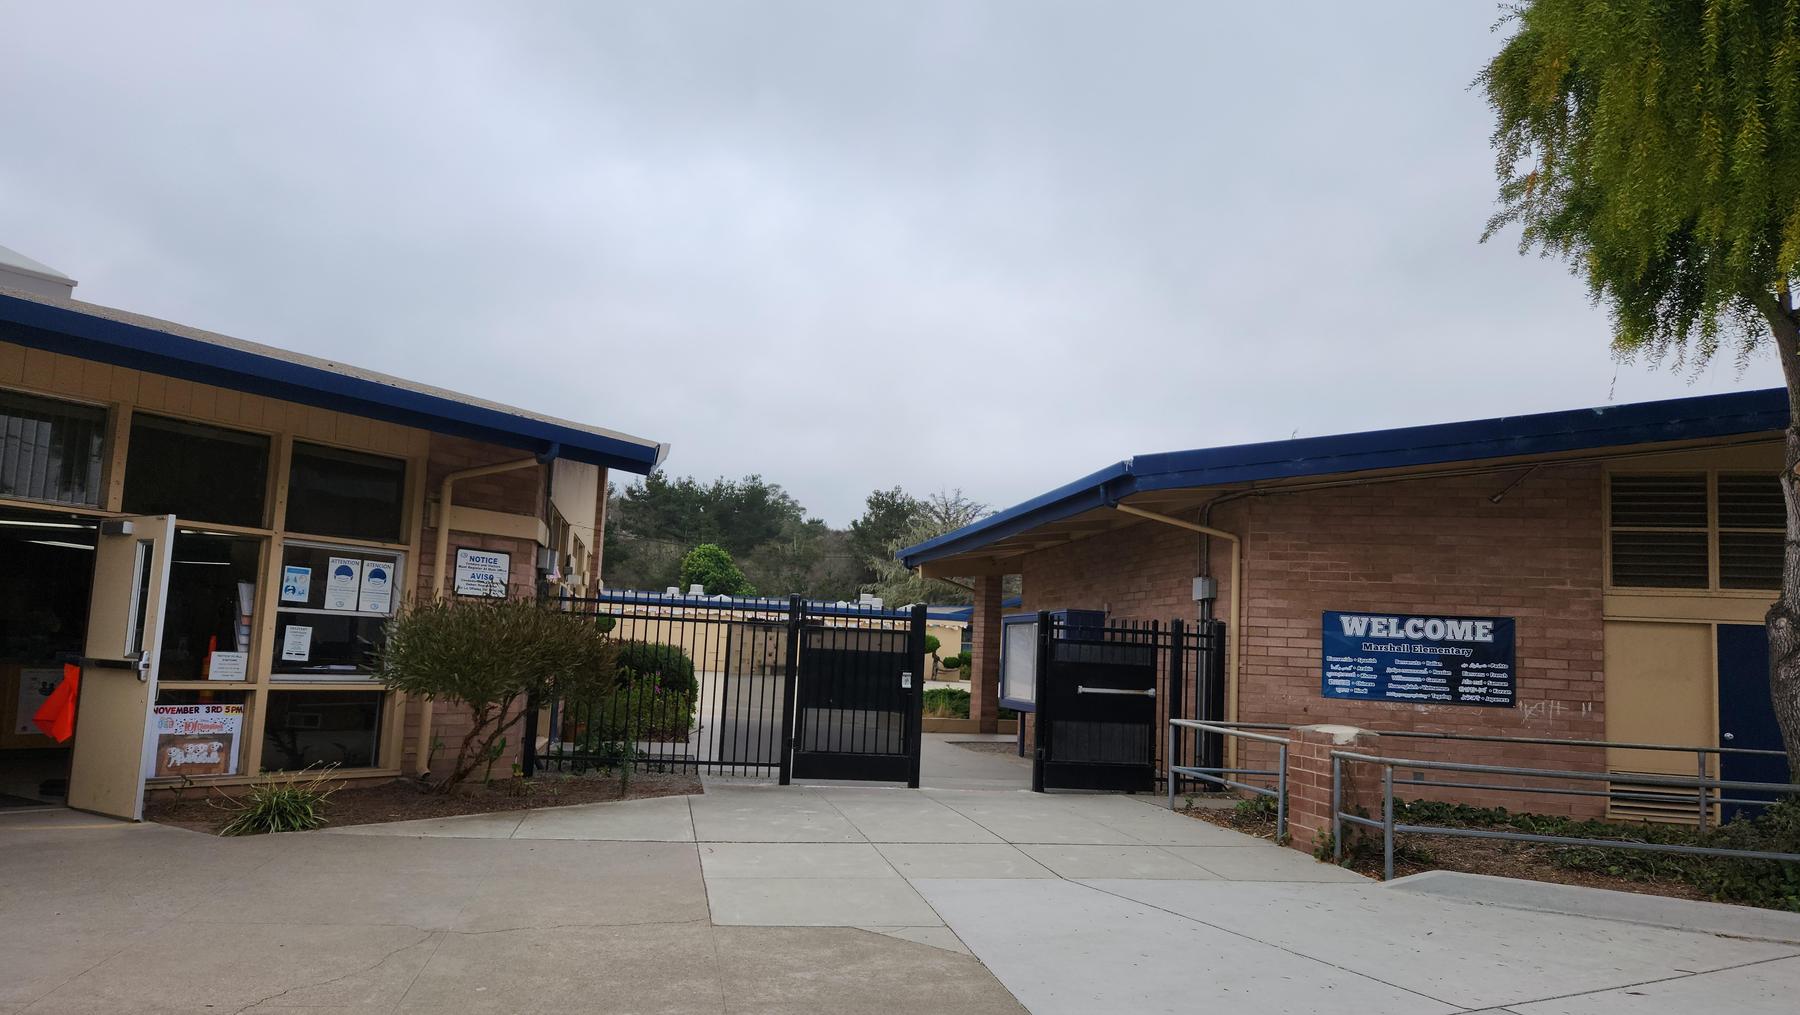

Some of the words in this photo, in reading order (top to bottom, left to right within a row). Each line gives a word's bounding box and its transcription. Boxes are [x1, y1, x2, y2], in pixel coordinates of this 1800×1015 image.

[470, 556, 498, 564] NOTICE
[1339, 615, 1494, 642] WELCOME
[1362, 642, 1410, 653] Marshall
[1411, 644, 1473, 657] Elementary
[154, 706, 199, 714] NOVEMBER
